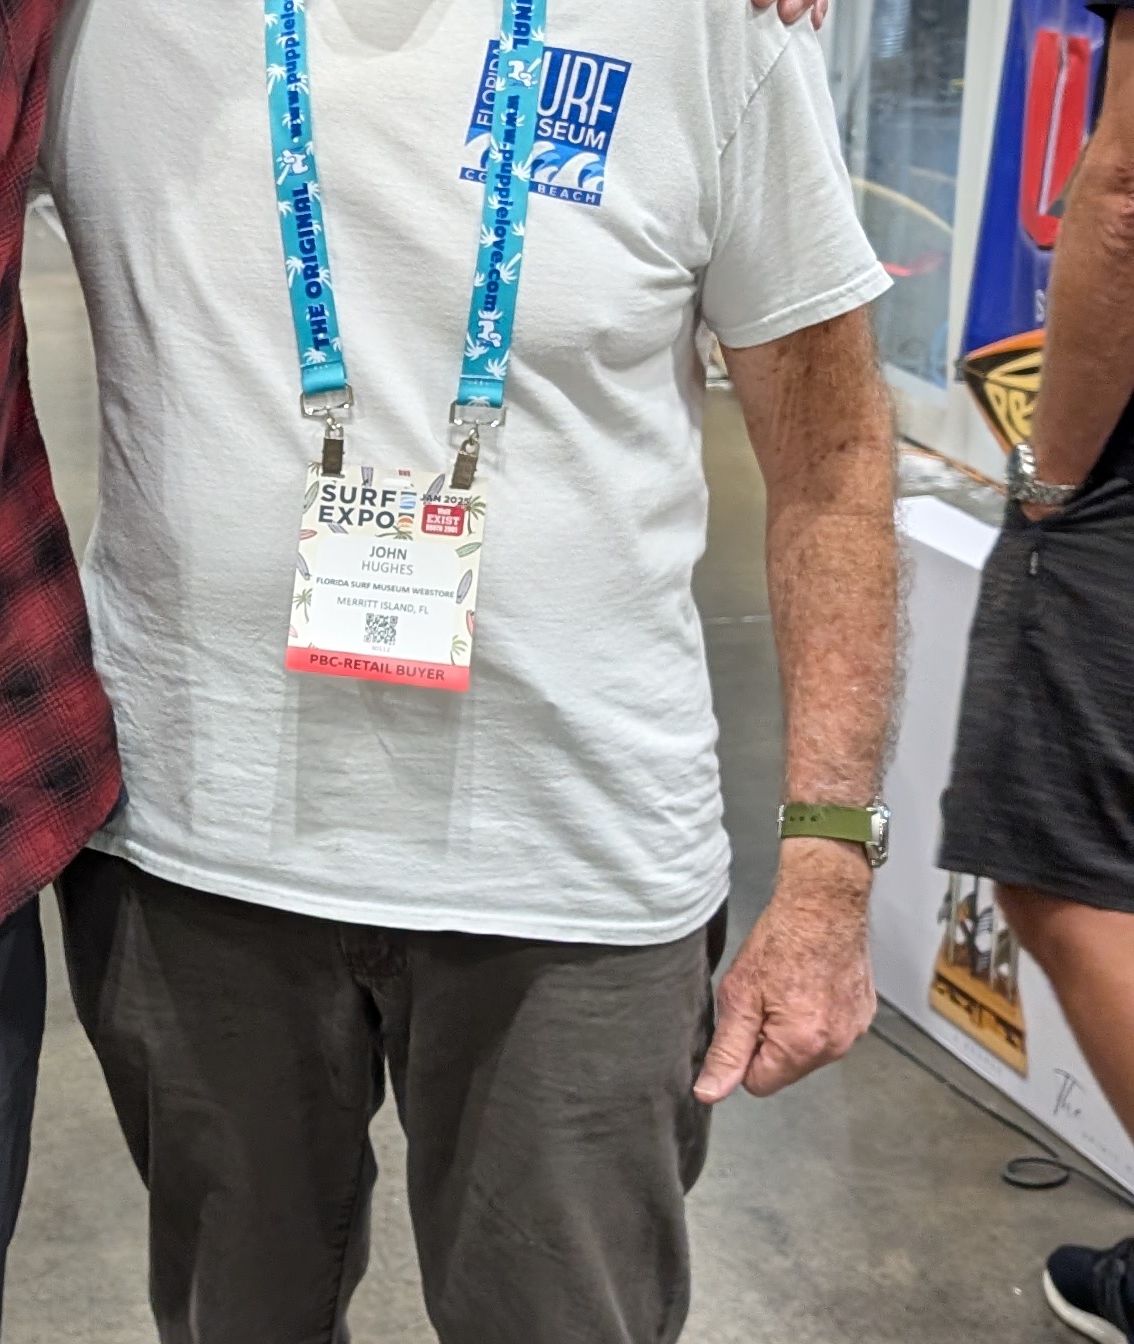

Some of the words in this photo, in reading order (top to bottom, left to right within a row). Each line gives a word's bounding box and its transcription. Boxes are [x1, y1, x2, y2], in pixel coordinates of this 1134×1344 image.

[537, 51, 627, 126] URF
[537, 120, 607, 150] SEUM
[537, 184, 596, 203] BEACH
[293, 183, 322, 299] ORIGINAL
[306, 303, 330, 351] THE
[320, 483, 397, 509] SURF
[318, 505, 395, 530] EXPO
[426, 513, 461, 526] EXIST
[368, 545, 408, 561] JOHN
[361, 560, 414, 576] HUGHES
[316, 576, 349, 587] FLORIDA
[350, 580, 371, 590] SURF
[372, 582, 410, 594] MUSEUM
[412, 587, 455, 599] WEBSTORE
[336, 596, 378, 609] MERRITT
[380, 601, 417, 614] ISLAND,
[418, 605, 429, 615] FL
[309, 653, 393, 675] PBC-RETAIL
[395, 664, 446, 681] BUYER
